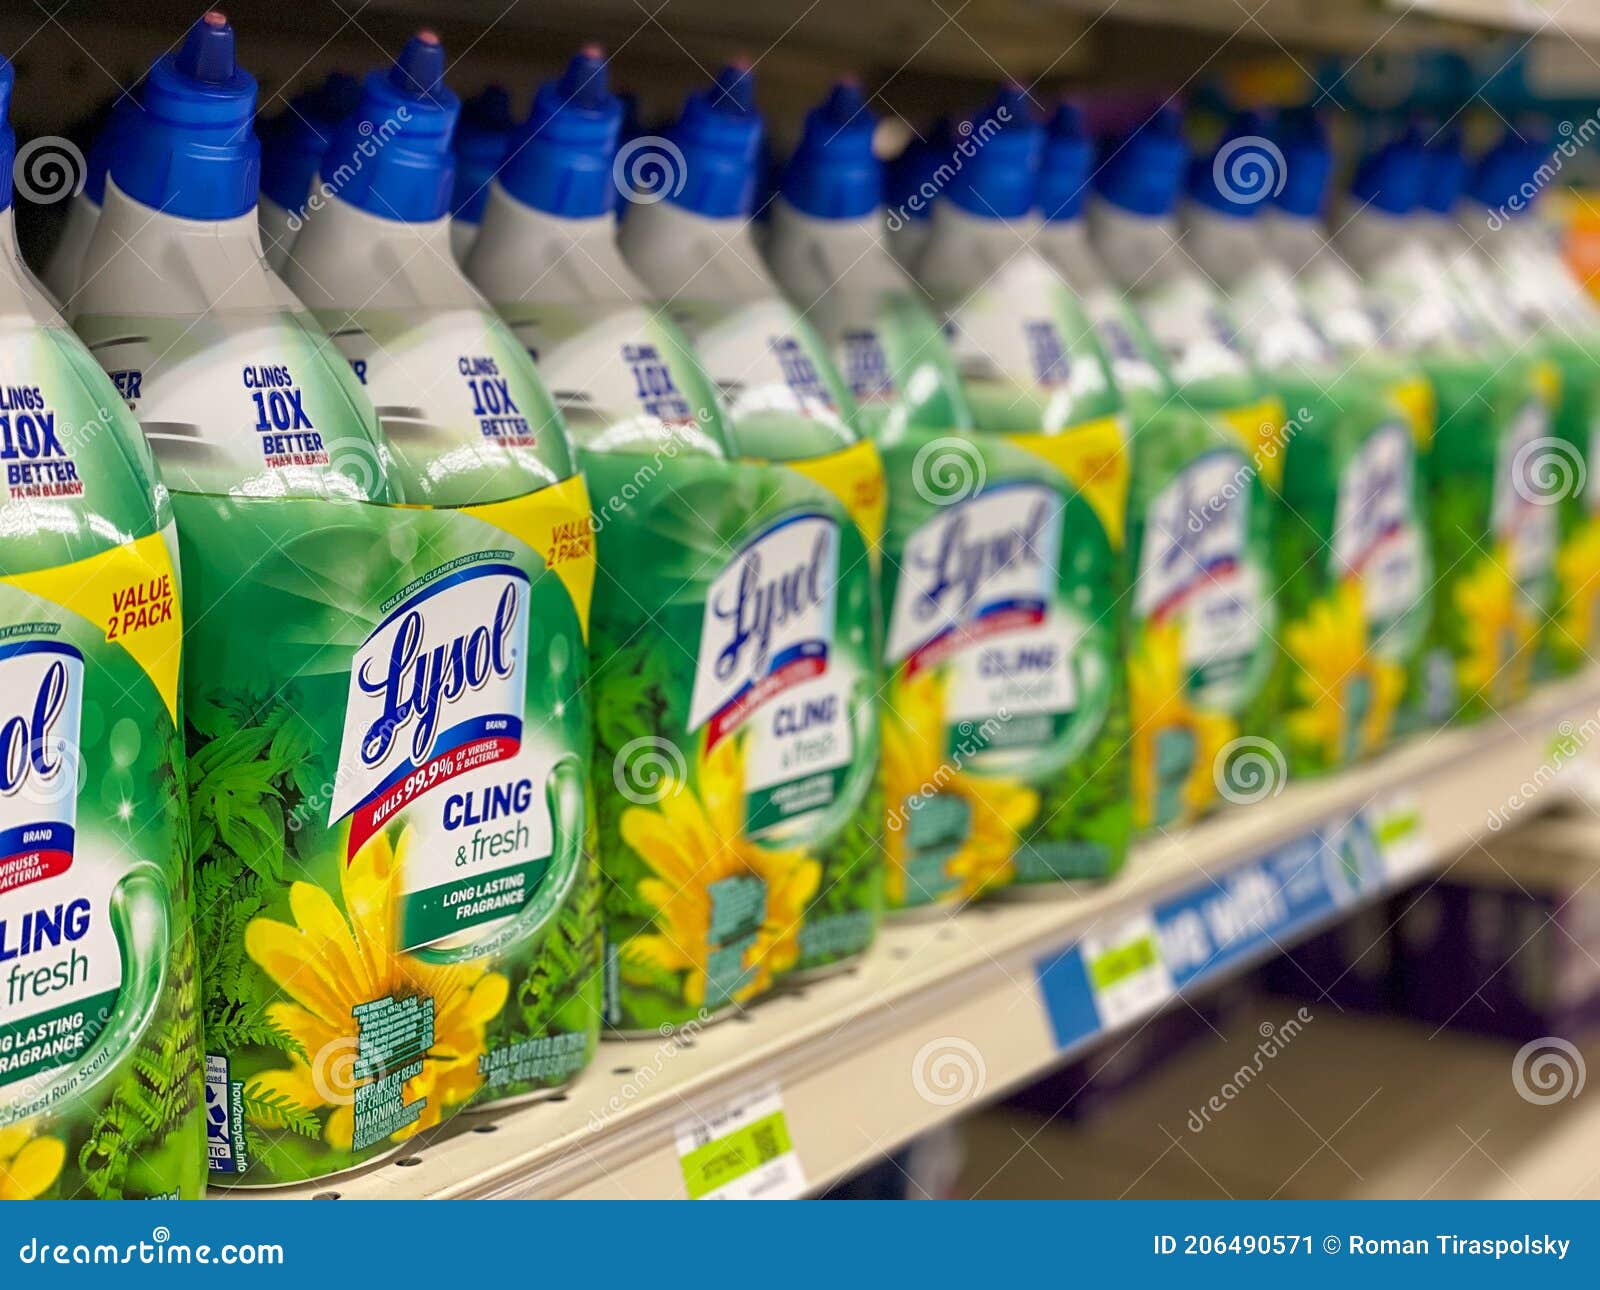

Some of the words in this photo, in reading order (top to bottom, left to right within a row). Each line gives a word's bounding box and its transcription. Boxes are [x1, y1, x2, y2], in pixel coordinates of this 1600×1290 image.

[243, 365, 293, 389] CLINGS
[0, 387, 45, 411] LINGS
[252, 387, 313, 432] 10X
[467, 379, 520, 416] 10X
[0, 411, 67, 460] 10X
[263, 431, 324, 455] BETTER
[481, 418, 530, 437] BETTER
[8, 461, 79, 485] BETTER
[265, 455, 293, 468] THAN
[112, 574, 171, 613] VALUE
[107, 616, 118, 640] 2
[122, 598, 172, 636] PACK
[358, 582, 516, 764] Lysol
[456, 749, 466, 761] OF
[467, 740, 497, 757] VIRUSES
[456, 761, 462, 771] &
[372, 789, 403, 827] KILLS
[405, 756, 454, 800] 99.9%
[443, 779, 532, 831] CLING
[23, 829, 52, 843] BRAND
[455, 846, 467, 867] &
[471, 820, 529, 863] fresh
[443, 886, 474, 908] LONG
[476, 873, 525, 896] LASTING
[456, 889, 525, 919] FRAGRANCE
[0, 898, 91, 962] LING
[7, 948, 88, 1005] fresh
[16, 1012, 84, 1047] LASTING
[0, 1031, 85, 1073] RAGRANCE
[12, 1093, 49, 1121] Forest
[52, 1077, 78, 1101] Rain
[79, 1047, 110, 1081] Scent
[355, 1082, 376, 1103] KEEP
[377, 1076, 392, 1093] OUT
[392, 1072, 401, 1085] OF
[401, 1060, 423, 1081] REACH
[355, 1101, 366, 1114] OF
[368, 1082, 402, 1109] CHILDREN
[232, 1083, 247, 1172] how2recycle.info
[355, 1097, 403, 1131] WARNING:
